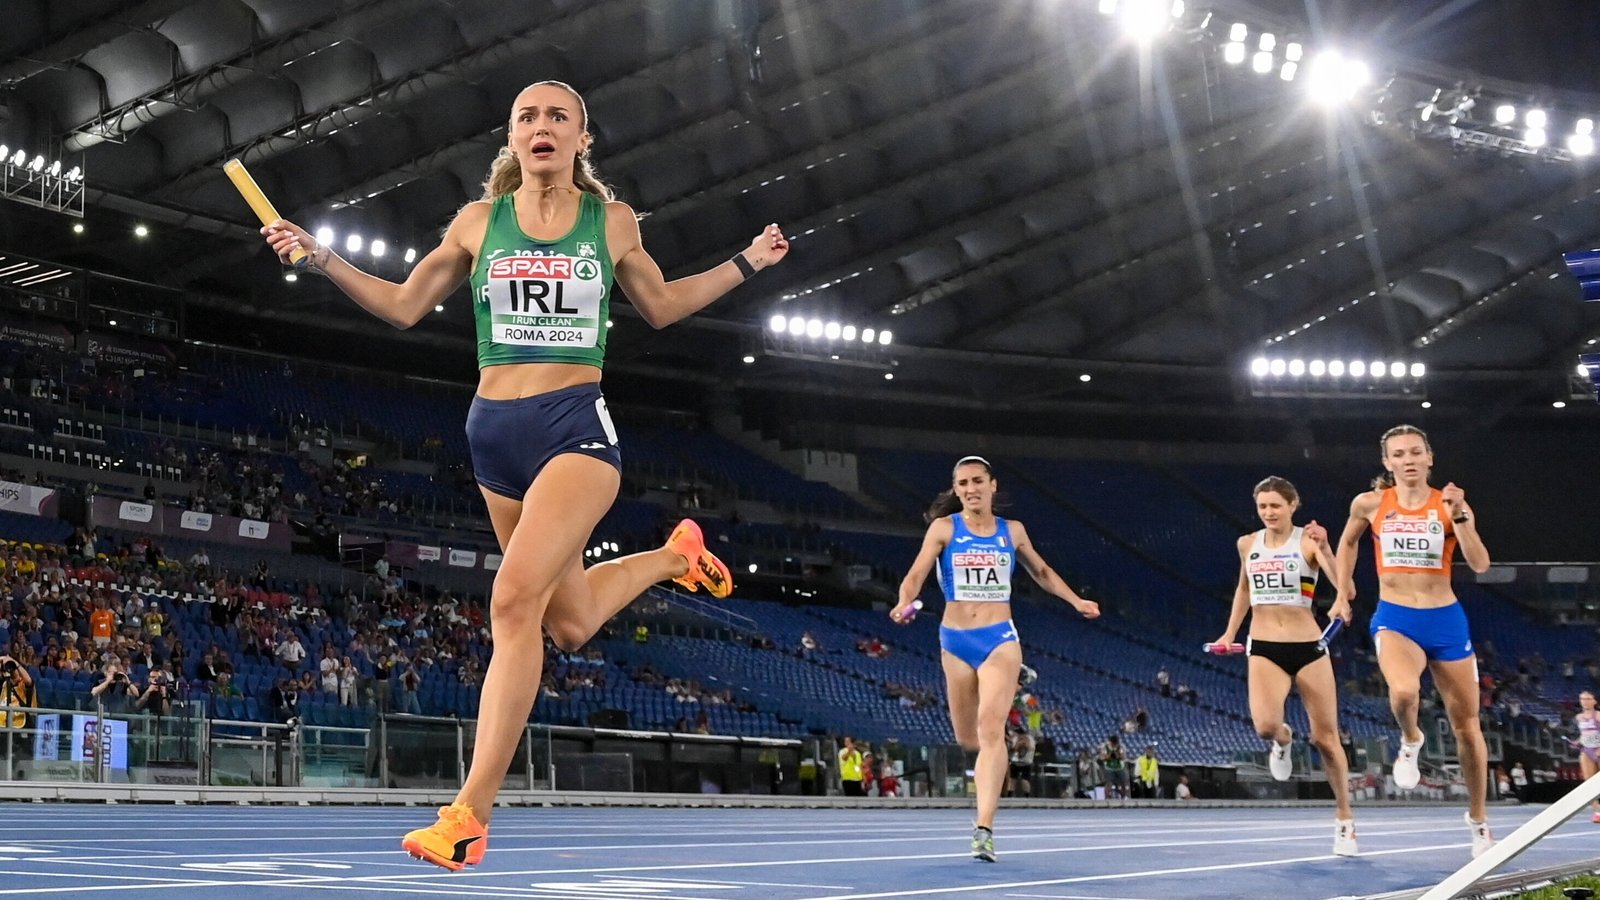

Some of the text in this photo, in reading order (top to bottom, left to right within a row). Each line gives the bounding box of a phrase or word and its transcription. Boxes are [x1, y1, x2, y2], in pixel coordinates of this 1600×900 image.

[492, 259, 570, 277] SPAR
[509, 279, 579, 315] IRL
[512, 316, 517, 324] I
[517, 316, 537, 325] RUN
[505, 328, 583, 342] ROMA 2024
[1383, 522, 1427, 532] SPAR
[1393, 537, 1430, 551] NED
[954, 555, 995, 566] SPAR
[1250, 561, 1284, 572] SPAR
[965, 567, 1000, 585] ITA
[1252, 572, 1294, 589] BEL
